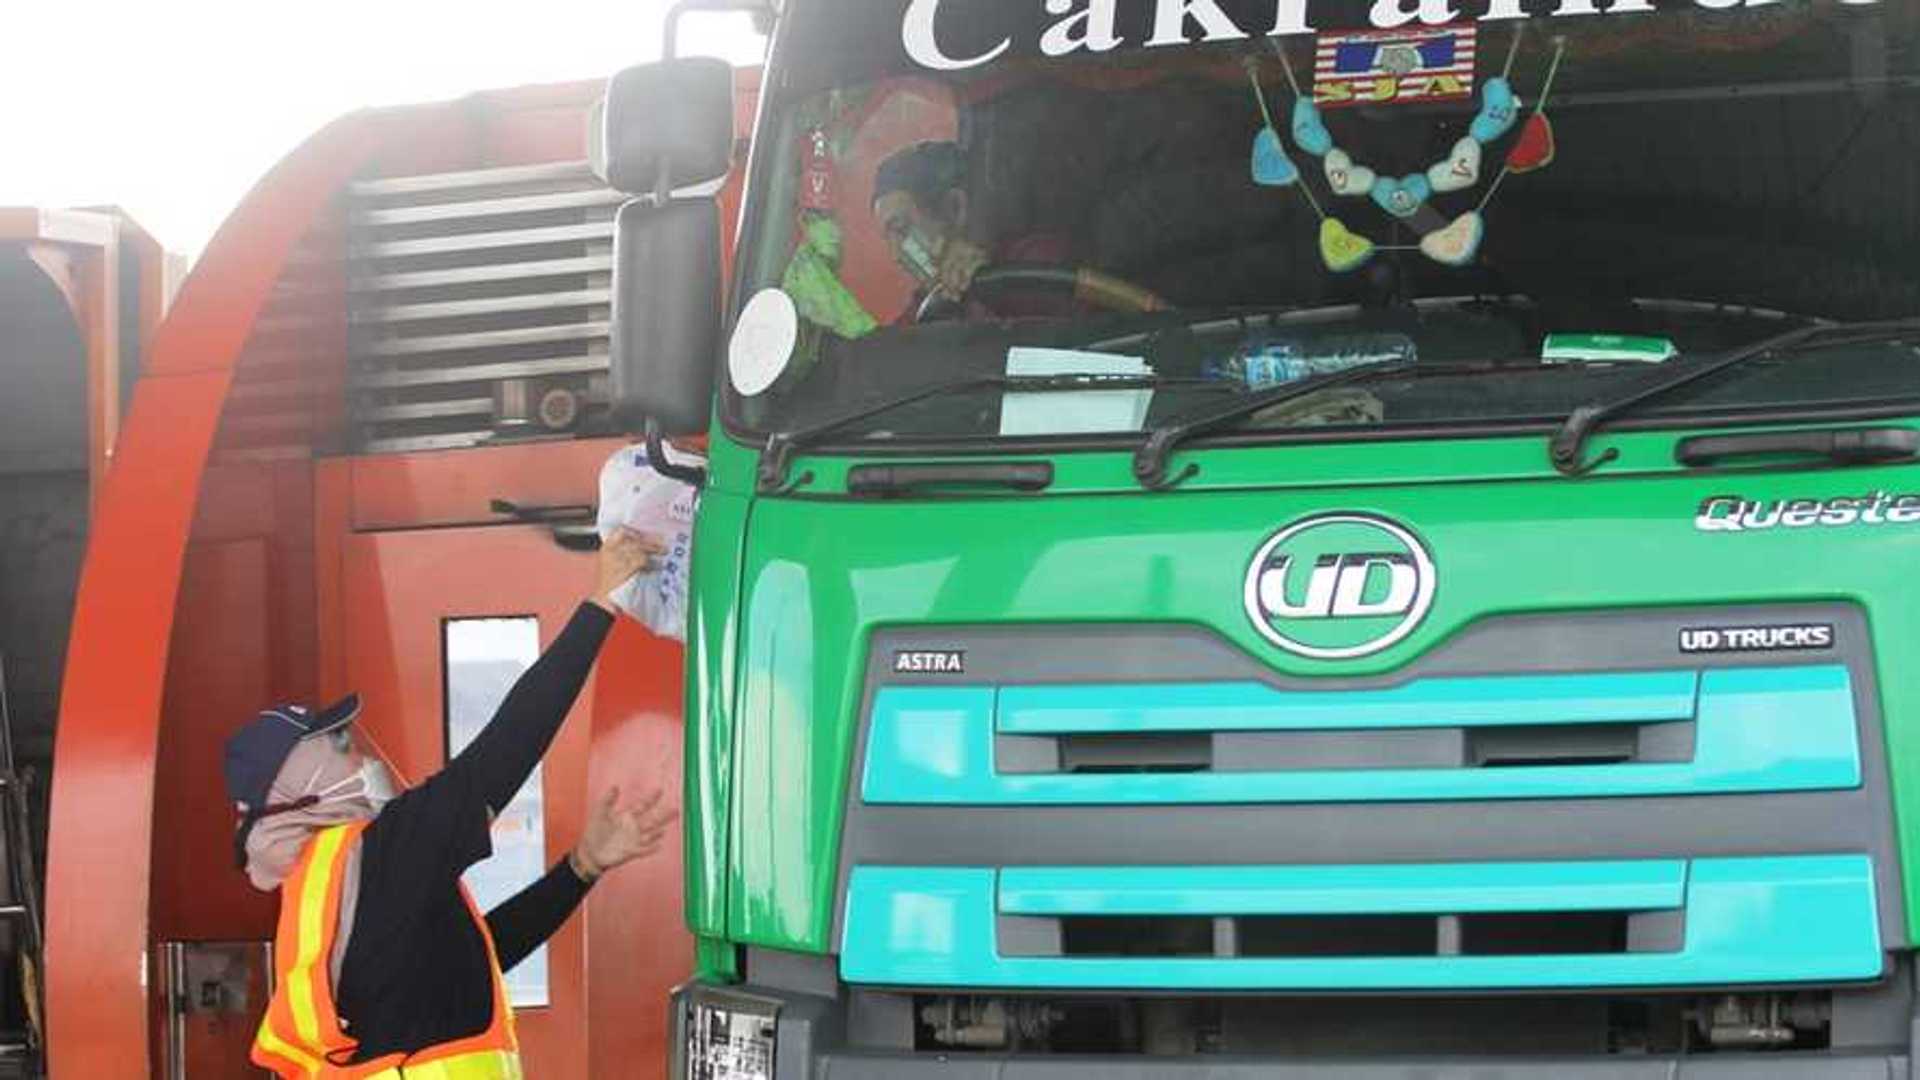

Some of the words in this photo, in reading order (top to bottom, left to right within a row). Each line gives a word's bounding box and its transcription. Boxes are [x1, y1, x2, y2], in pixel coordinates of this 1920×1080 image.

[1259, 553, 1418, 618] UD
[1681, 630, 1720, 650] UD
[1723, 627, 1831, 648] TRUCKS
[897, 652, 961, 671] ASTRA
